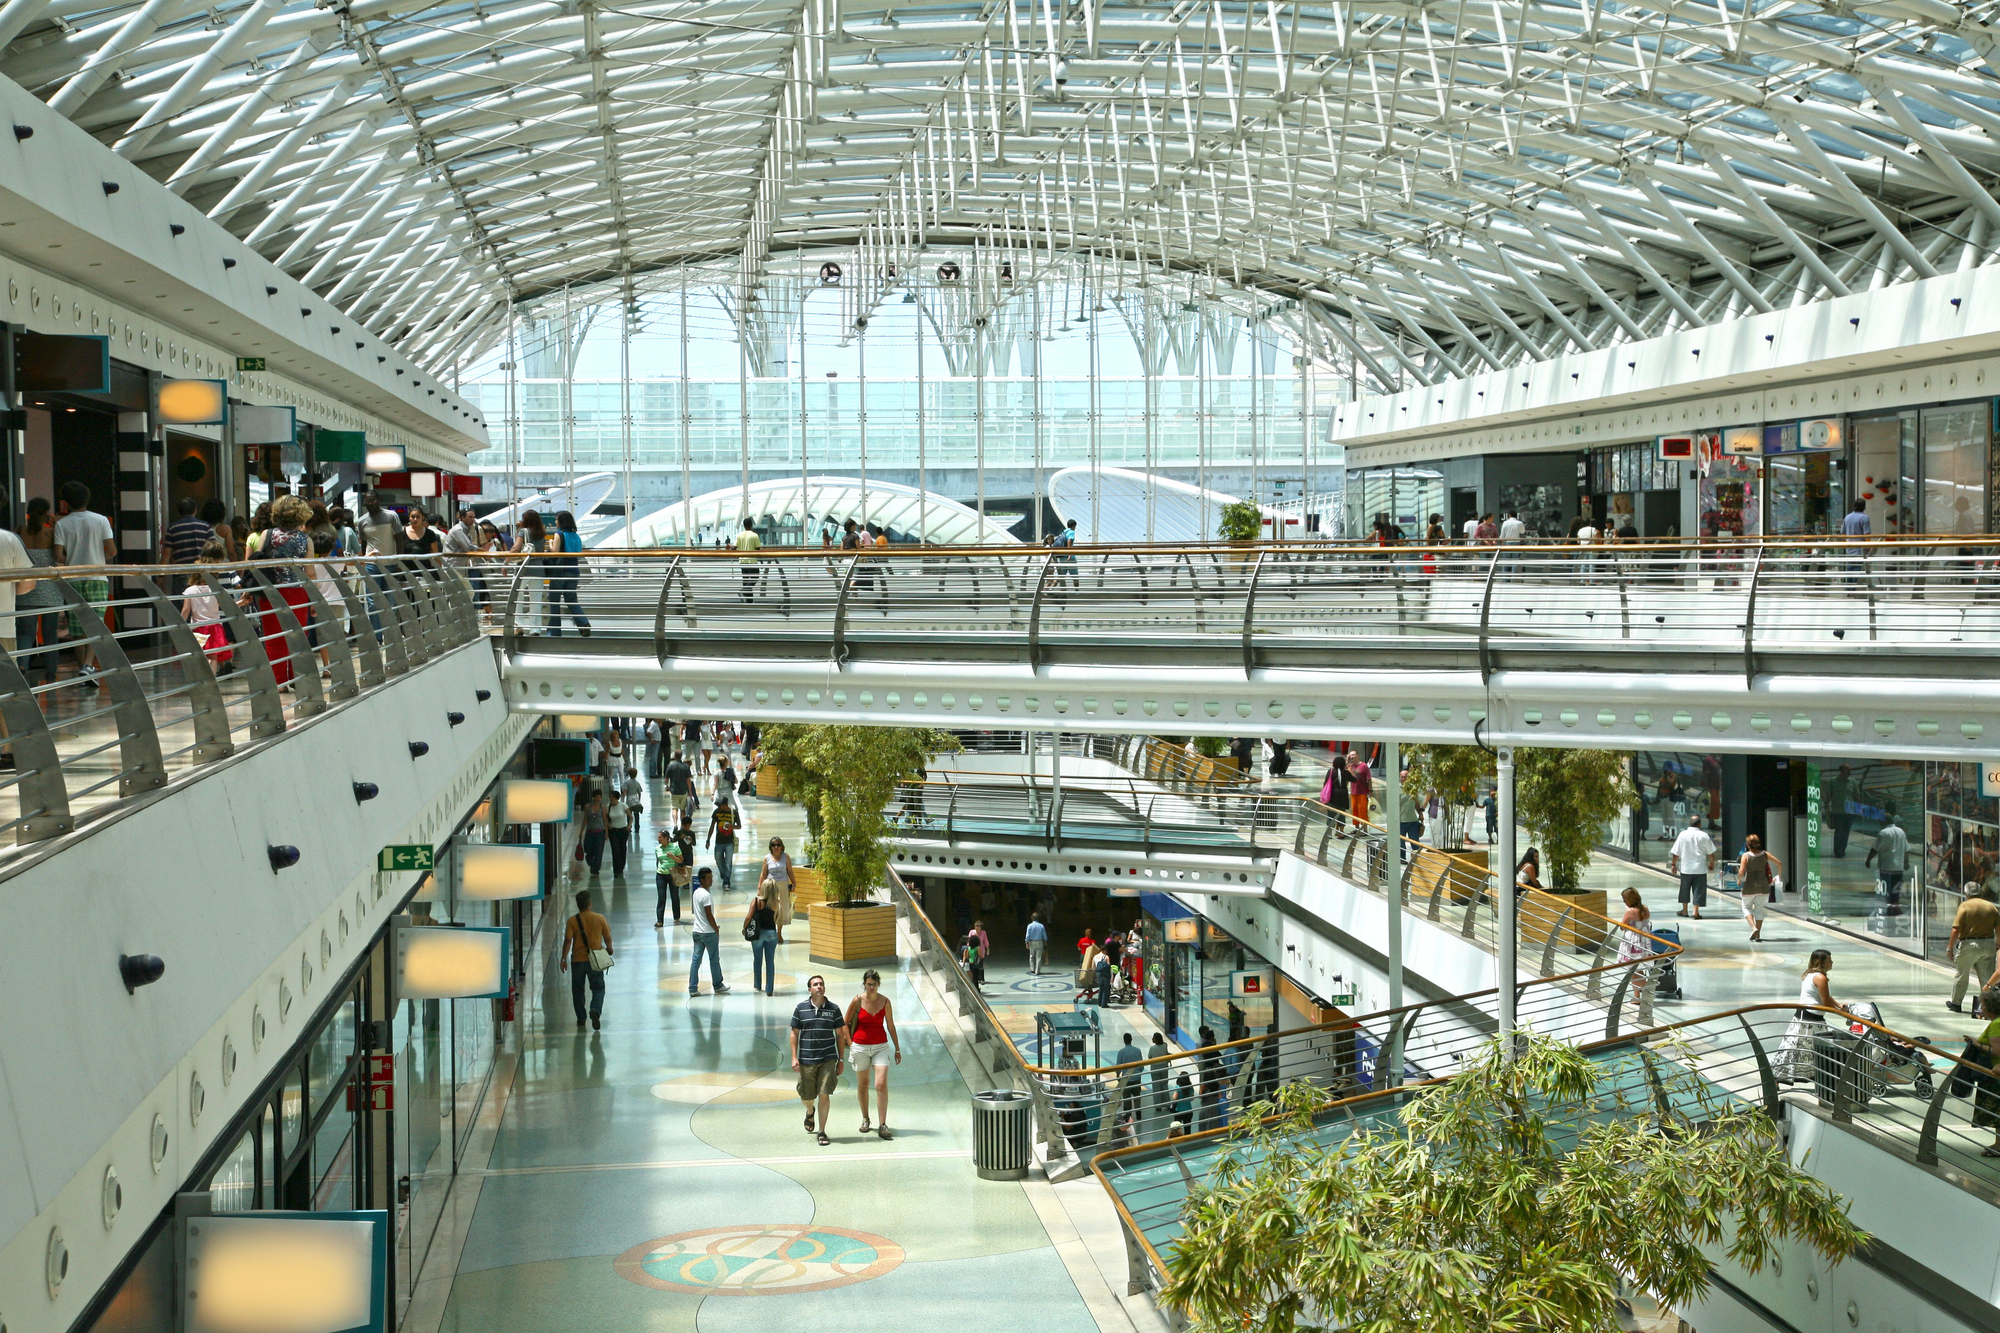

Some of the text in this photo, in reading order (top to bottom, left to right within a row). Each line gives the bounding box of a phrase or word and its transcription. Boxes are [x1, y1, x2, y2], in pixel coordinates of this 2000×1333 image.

[1807, 785, 1820, 800] PRO
[1807, 801, 1819, 815] MO
[1807, 834, 1817, 849] ES
